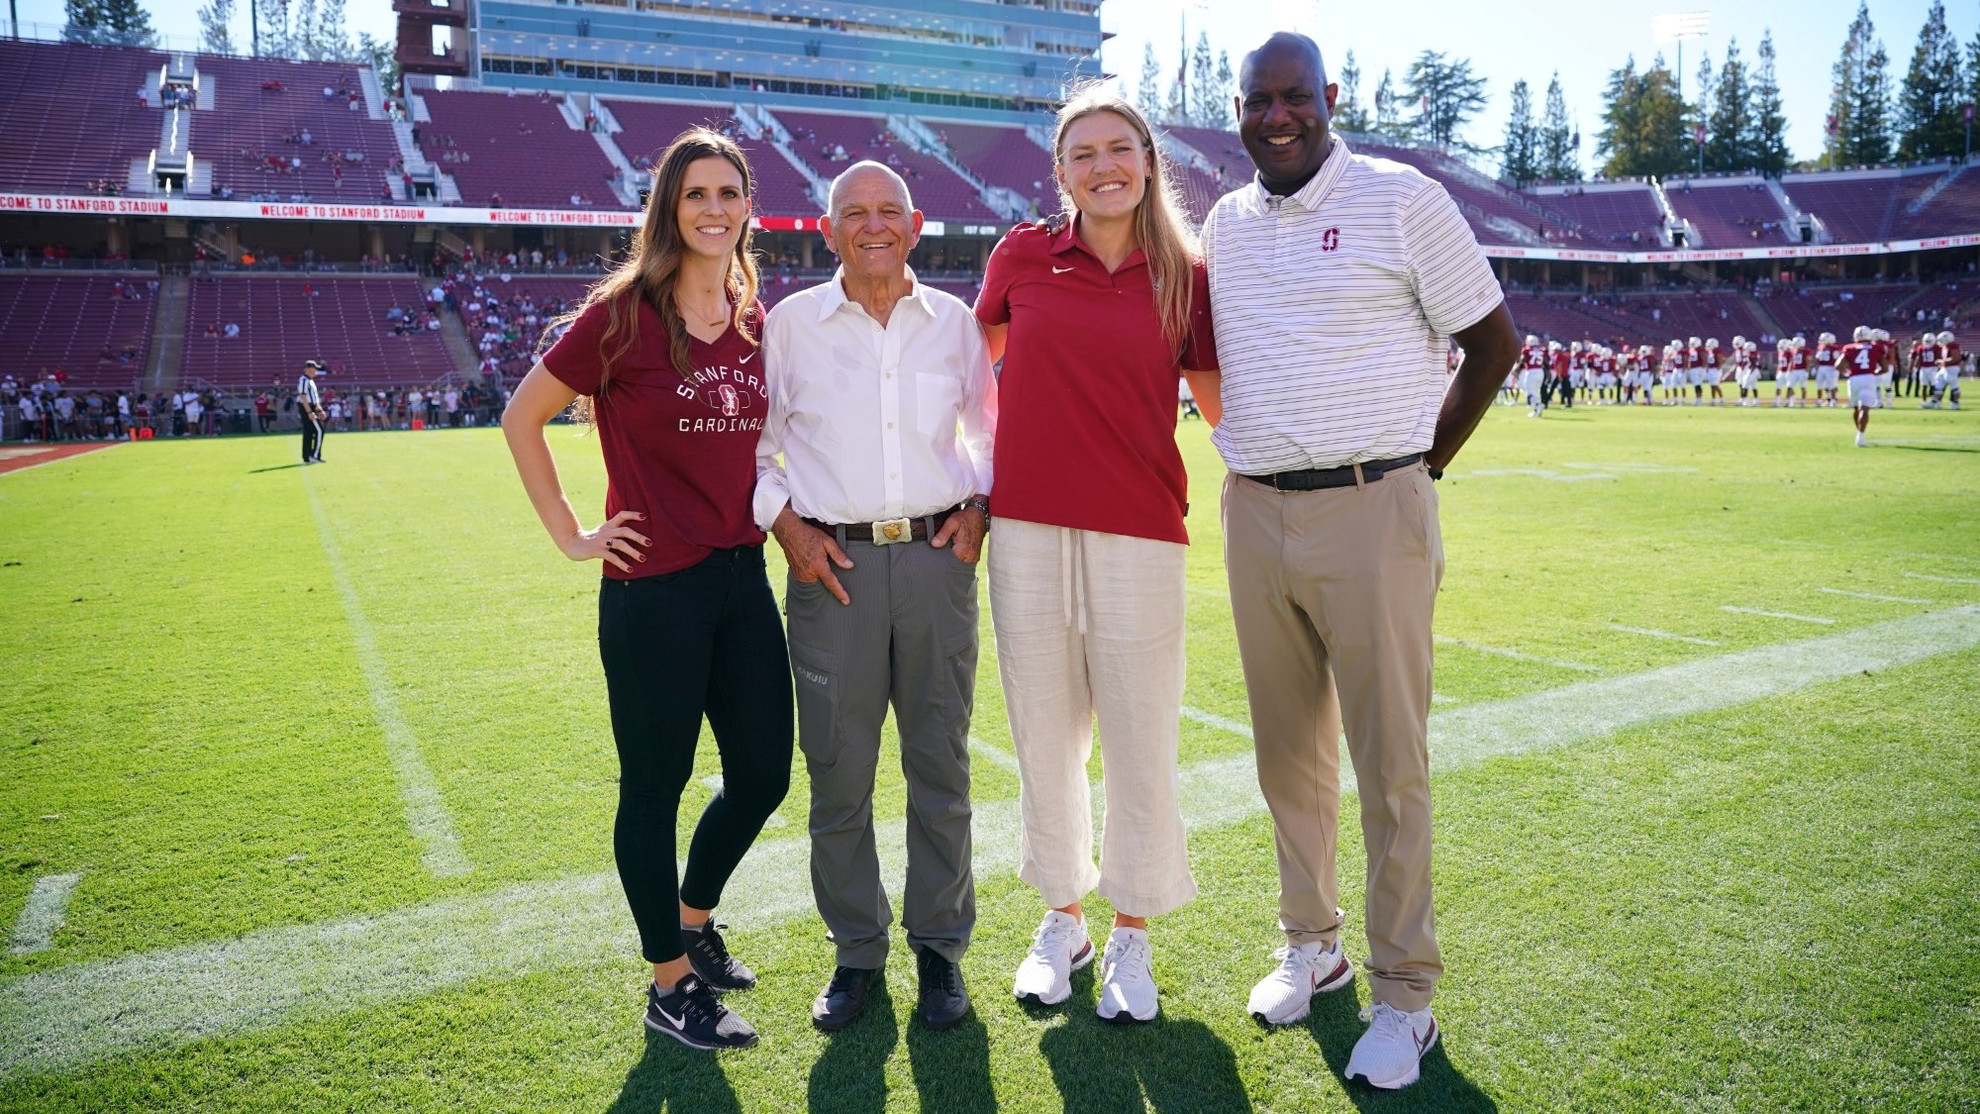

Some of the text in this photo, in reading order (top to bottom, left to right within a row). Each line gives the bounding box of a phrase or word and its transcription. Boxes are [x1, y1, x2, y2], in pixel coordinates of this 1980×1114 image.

[38, 198, 52, 210] TO
[56, 198, 115, 212] STANFORD
[119, 200, 169, 213] STADIUM
[261, 205, 425, 220] WELCOME TO STANFORD STADIUM
[489, 211, 634, 224] WELCOME TO STANFORD STADIUM
[1529, 351, 1544, 365] 75
[1854, 349, 1870, 369] 4
[676, 365, 768, 400] STANFORD
[679, 417, 764, 433] CARDINAL
